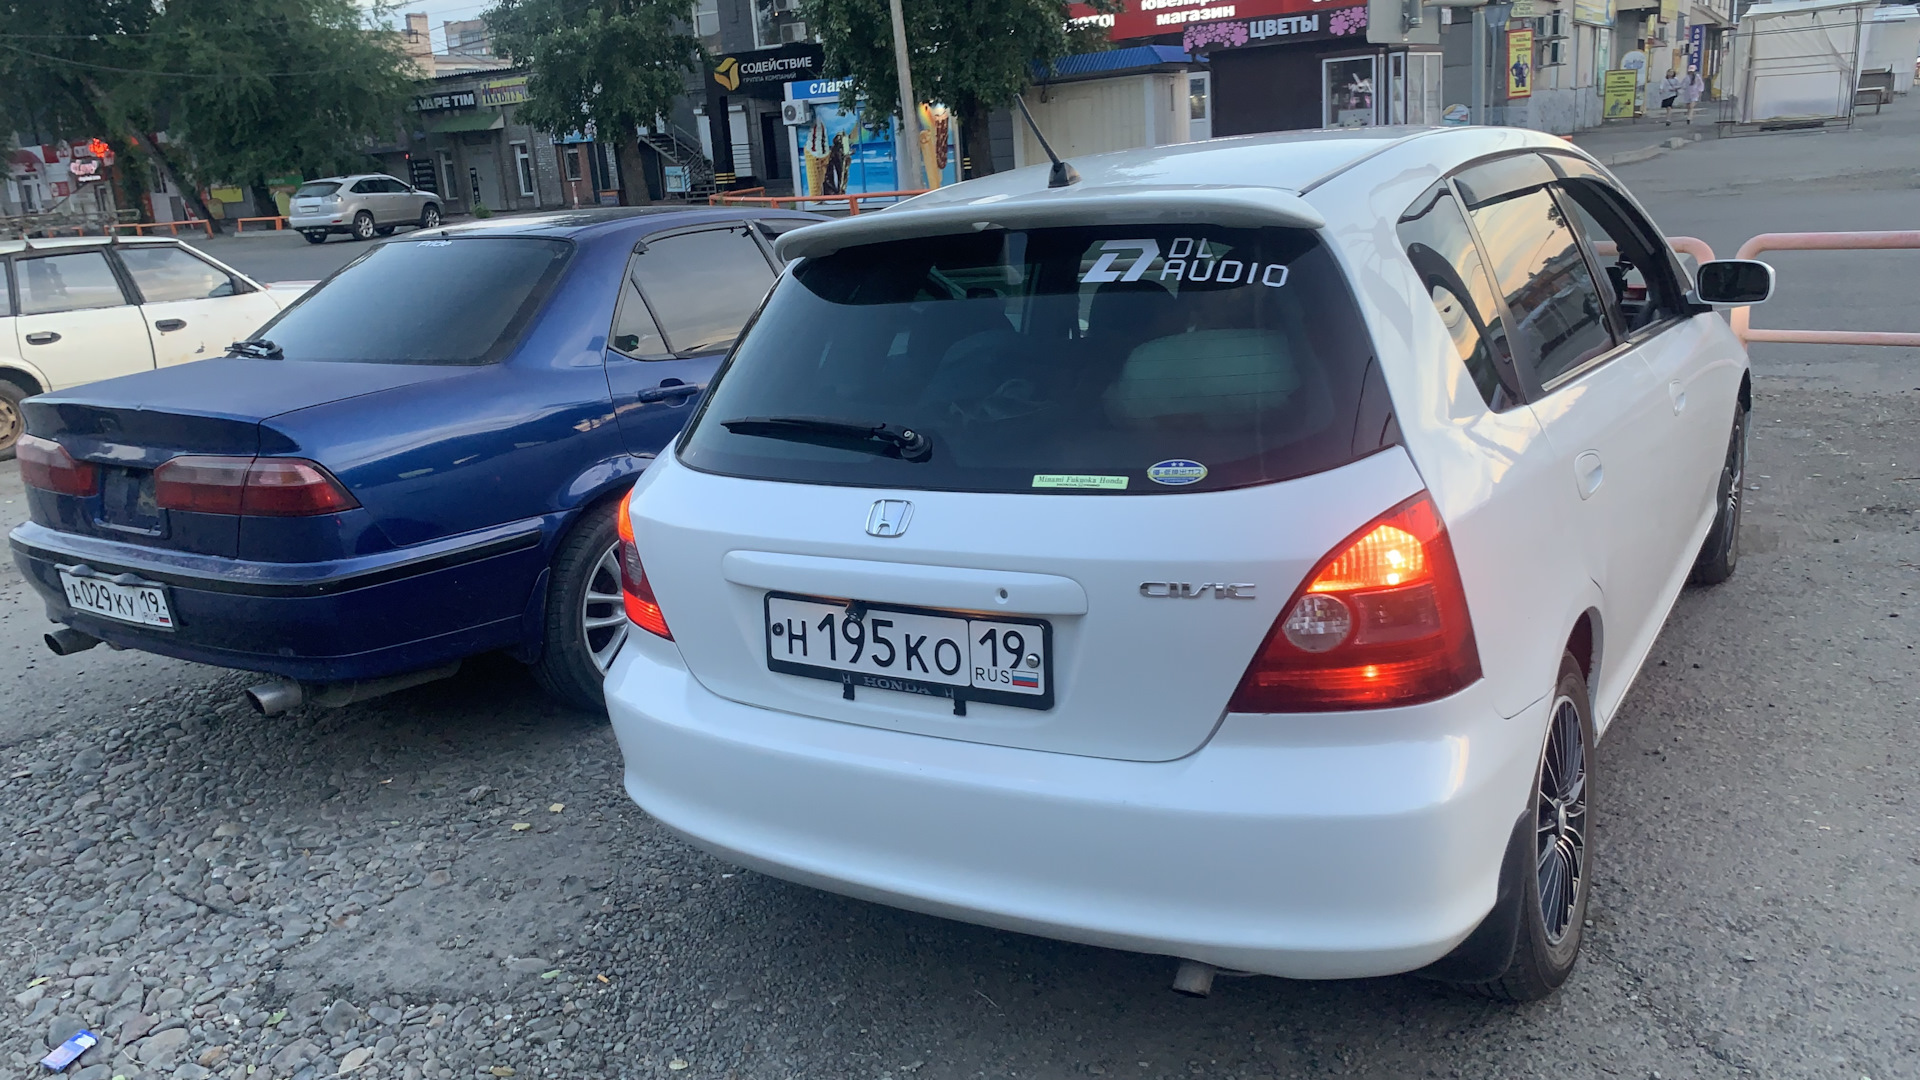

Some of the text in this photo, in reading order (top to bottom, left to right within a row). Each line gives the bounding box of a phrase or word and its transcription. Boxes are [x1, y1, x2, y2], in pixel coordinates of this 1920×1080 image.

[1156, 5, 1235, 26] магазин
[1250, 14, 1319, 40] ЦВЕТЫ
[1692, 27, 1701, 66] ЛОМБАР
[740, 56, 812, 74] СОДЕЙСТВИЕ
[419, 95, 451, 110] VAPE
[1168, 237, 1214, 258] DL
[1160, 259, 1289, 288] AUDIO
[1099, 477, 1124, 485] Honda
[1140, 581, 1256, 600] CIVIC
[140, 590, 159, 613] 19
[979, 628, 1025, 669] 19
[863, 677, 931, 695] HONDA
[975, 667, 1010, 684] RUS
